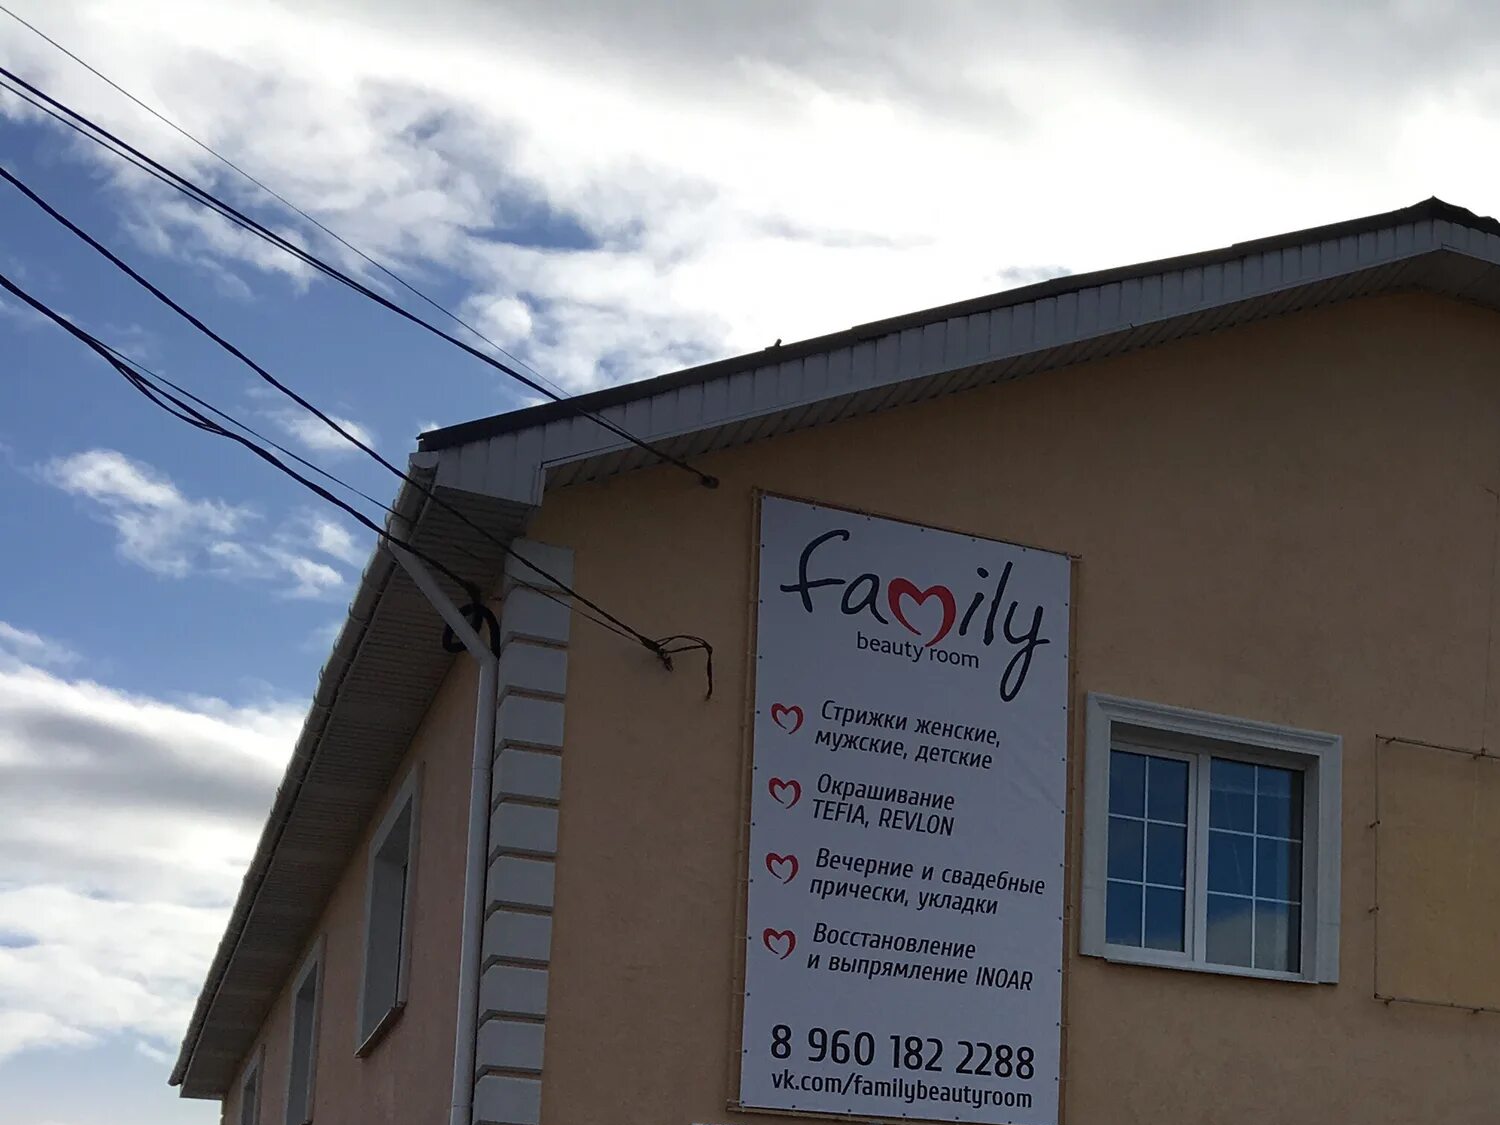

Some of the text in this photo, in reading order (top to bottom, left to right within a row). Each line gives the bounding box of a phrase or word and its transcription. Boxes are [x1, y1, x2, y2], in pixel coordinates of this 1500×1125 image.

[780, 529, 1050, 702] family
[856, 631, 980, 668] beauty room
[821, 700, 1001, 748] Стрижки женские,
[815, 730, 993, 769] мужские, детские
[817, 774, 955, 811] Окрашивание
[812, 799, 955, 836] TEFIA, REVLON
[815, 848, 1046, 895] Вечерние и свадебные
[810, 877, 999, 915] прически, укладки
[813, 923, 976, 959] Восстановление
[807, 954, 1034, 991] и выпрямление INOAR
[770, 1024, 1035, 1080] 8 960 182 2288
[772, 1071, 1033, 1109] vk.com/familybeautyroom
